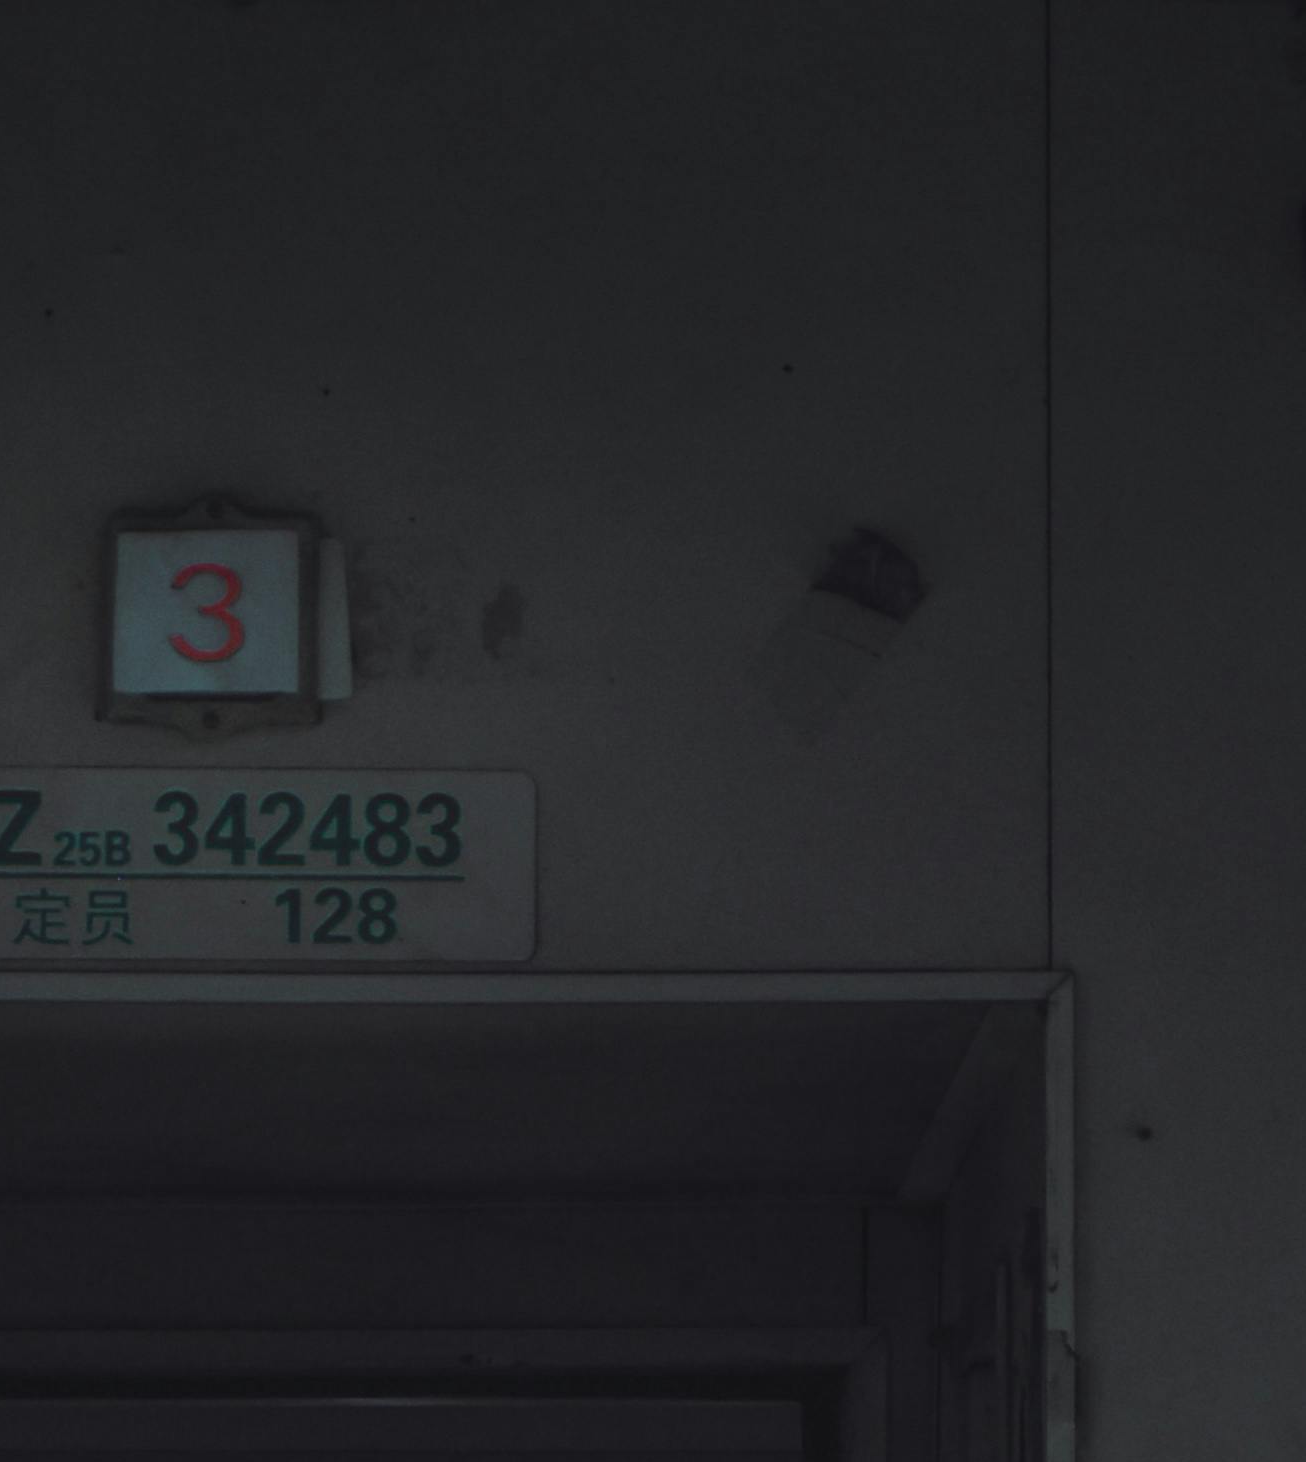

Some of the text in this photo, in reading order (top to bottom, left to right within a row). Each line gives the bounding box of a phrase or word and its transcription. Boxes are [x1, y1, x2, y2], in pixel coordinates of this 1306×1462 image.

[168, 562, 246, 664] 3
[152, 791, 463, 868] 342483
[12, 887, 396, 947] 定员 128
